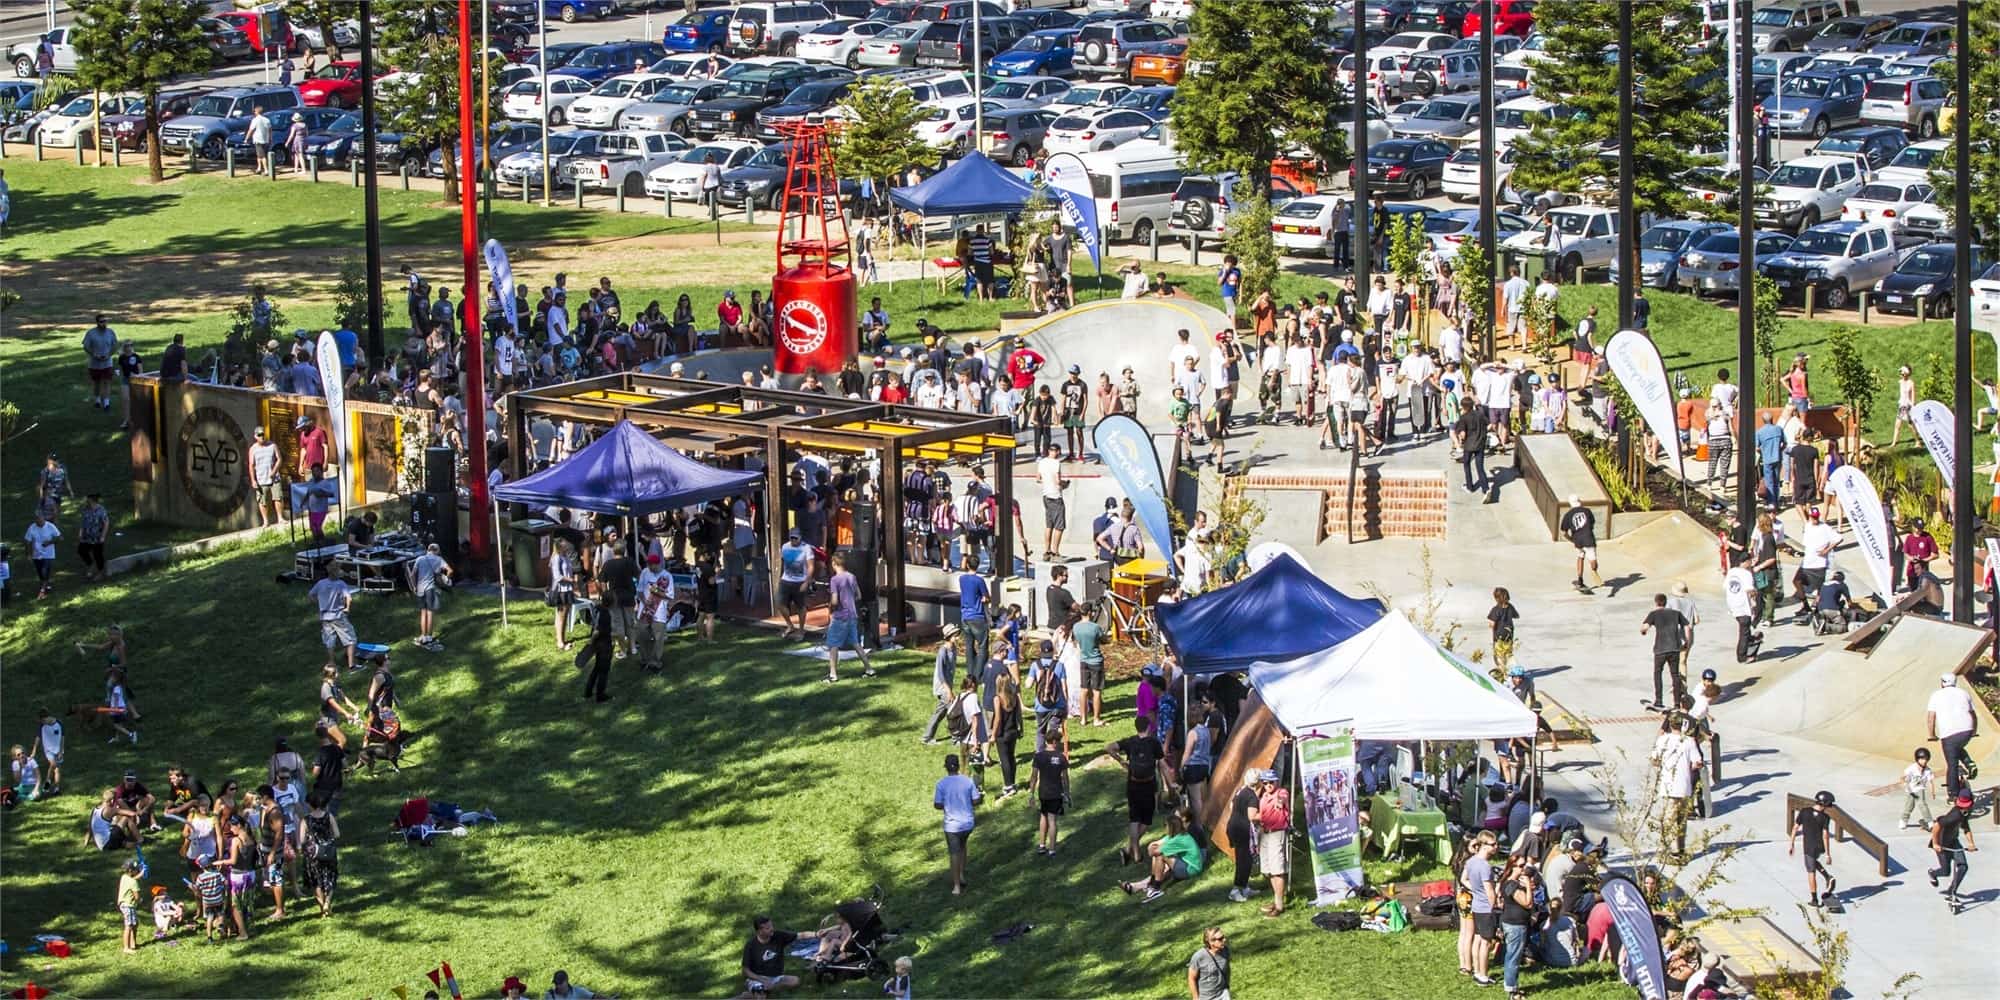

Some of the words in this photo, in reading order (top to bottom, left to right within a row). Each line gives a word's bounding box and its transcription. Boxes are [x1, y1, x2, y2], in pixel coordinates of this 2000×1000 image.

[566, 165, 594, 175] TOYOTA
[1060, 191, 1084, 225] FIRST
[1079, 226, 1095, 247] AID
[191, 438, 238, 479] EYP
